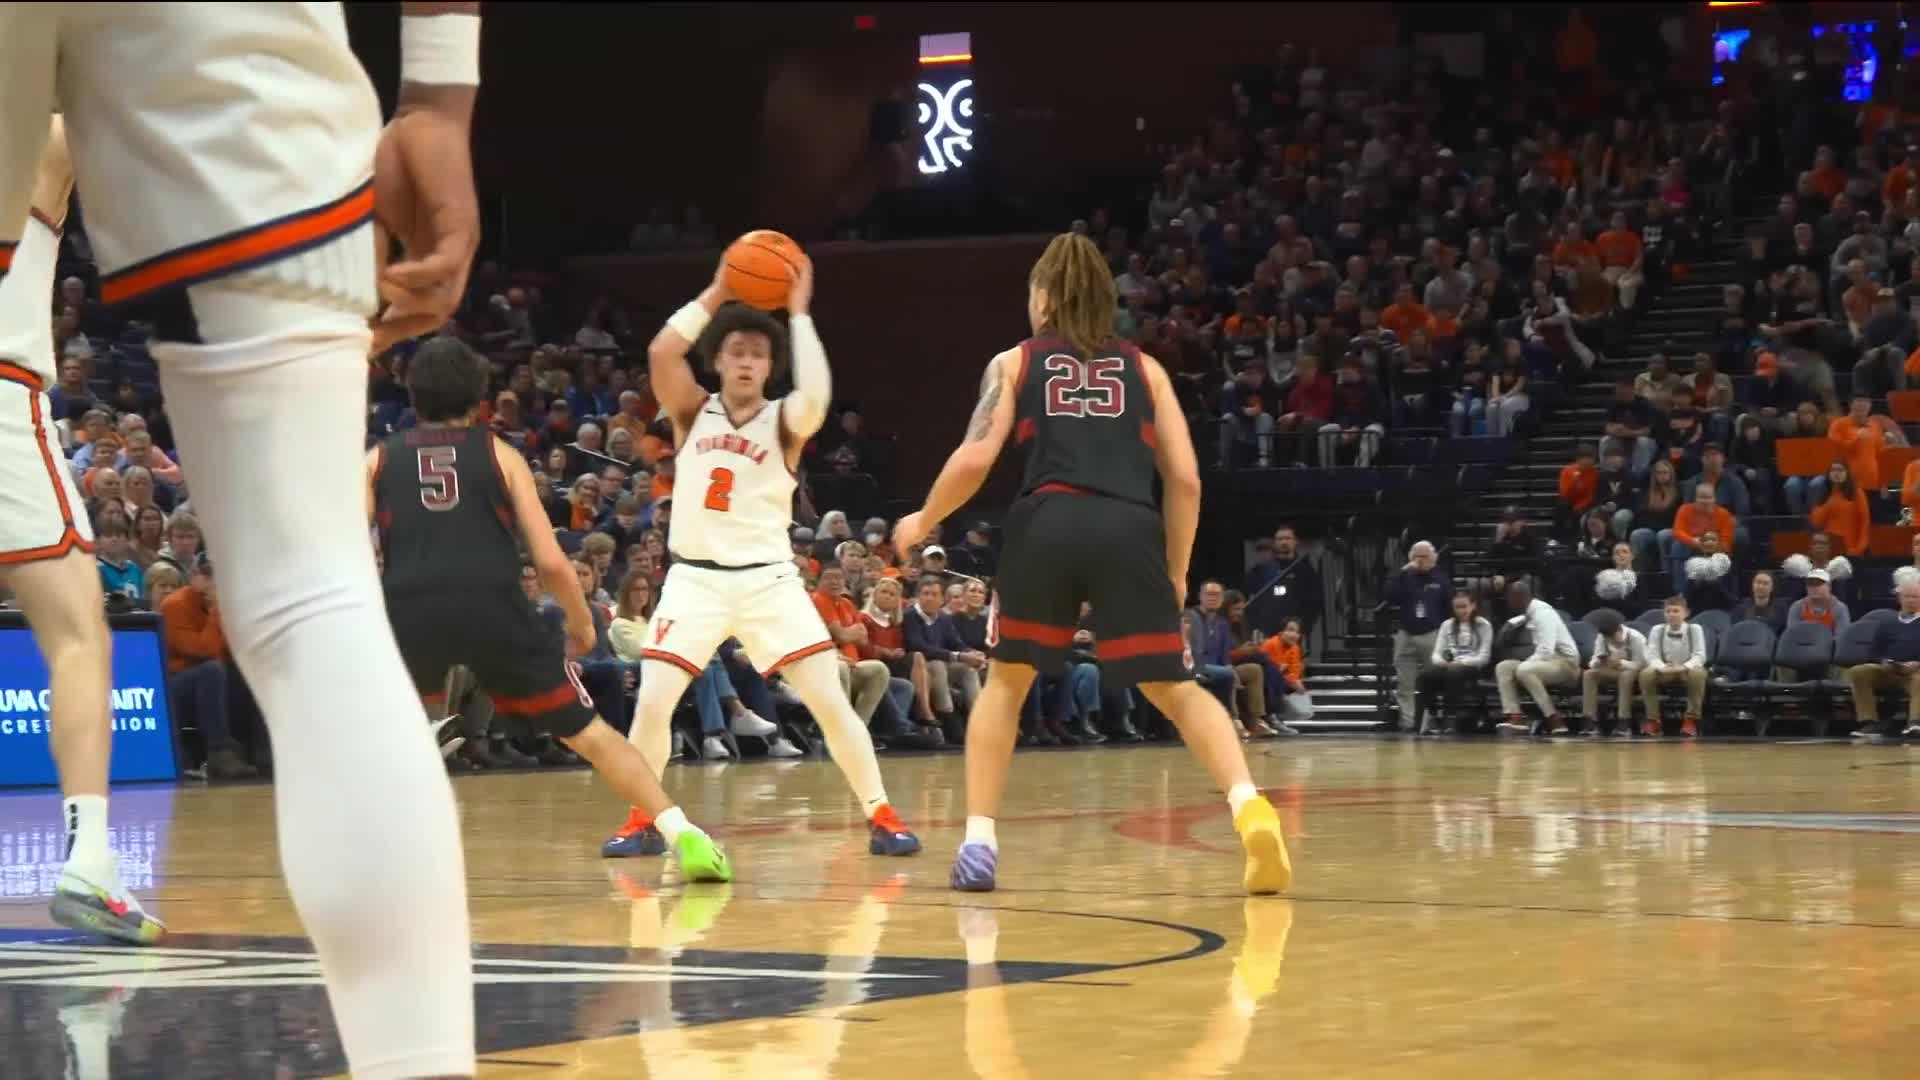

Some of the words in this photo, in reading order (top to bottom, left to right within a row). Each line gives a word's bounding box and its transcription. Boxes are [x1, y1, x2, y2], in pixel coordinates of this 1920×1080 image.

[1044, 354, 1125, 417] 25
[417, 445, 459, 511] 5
[704, 467, 733, 512] 2
[1, 719, 52, 734] CRE
